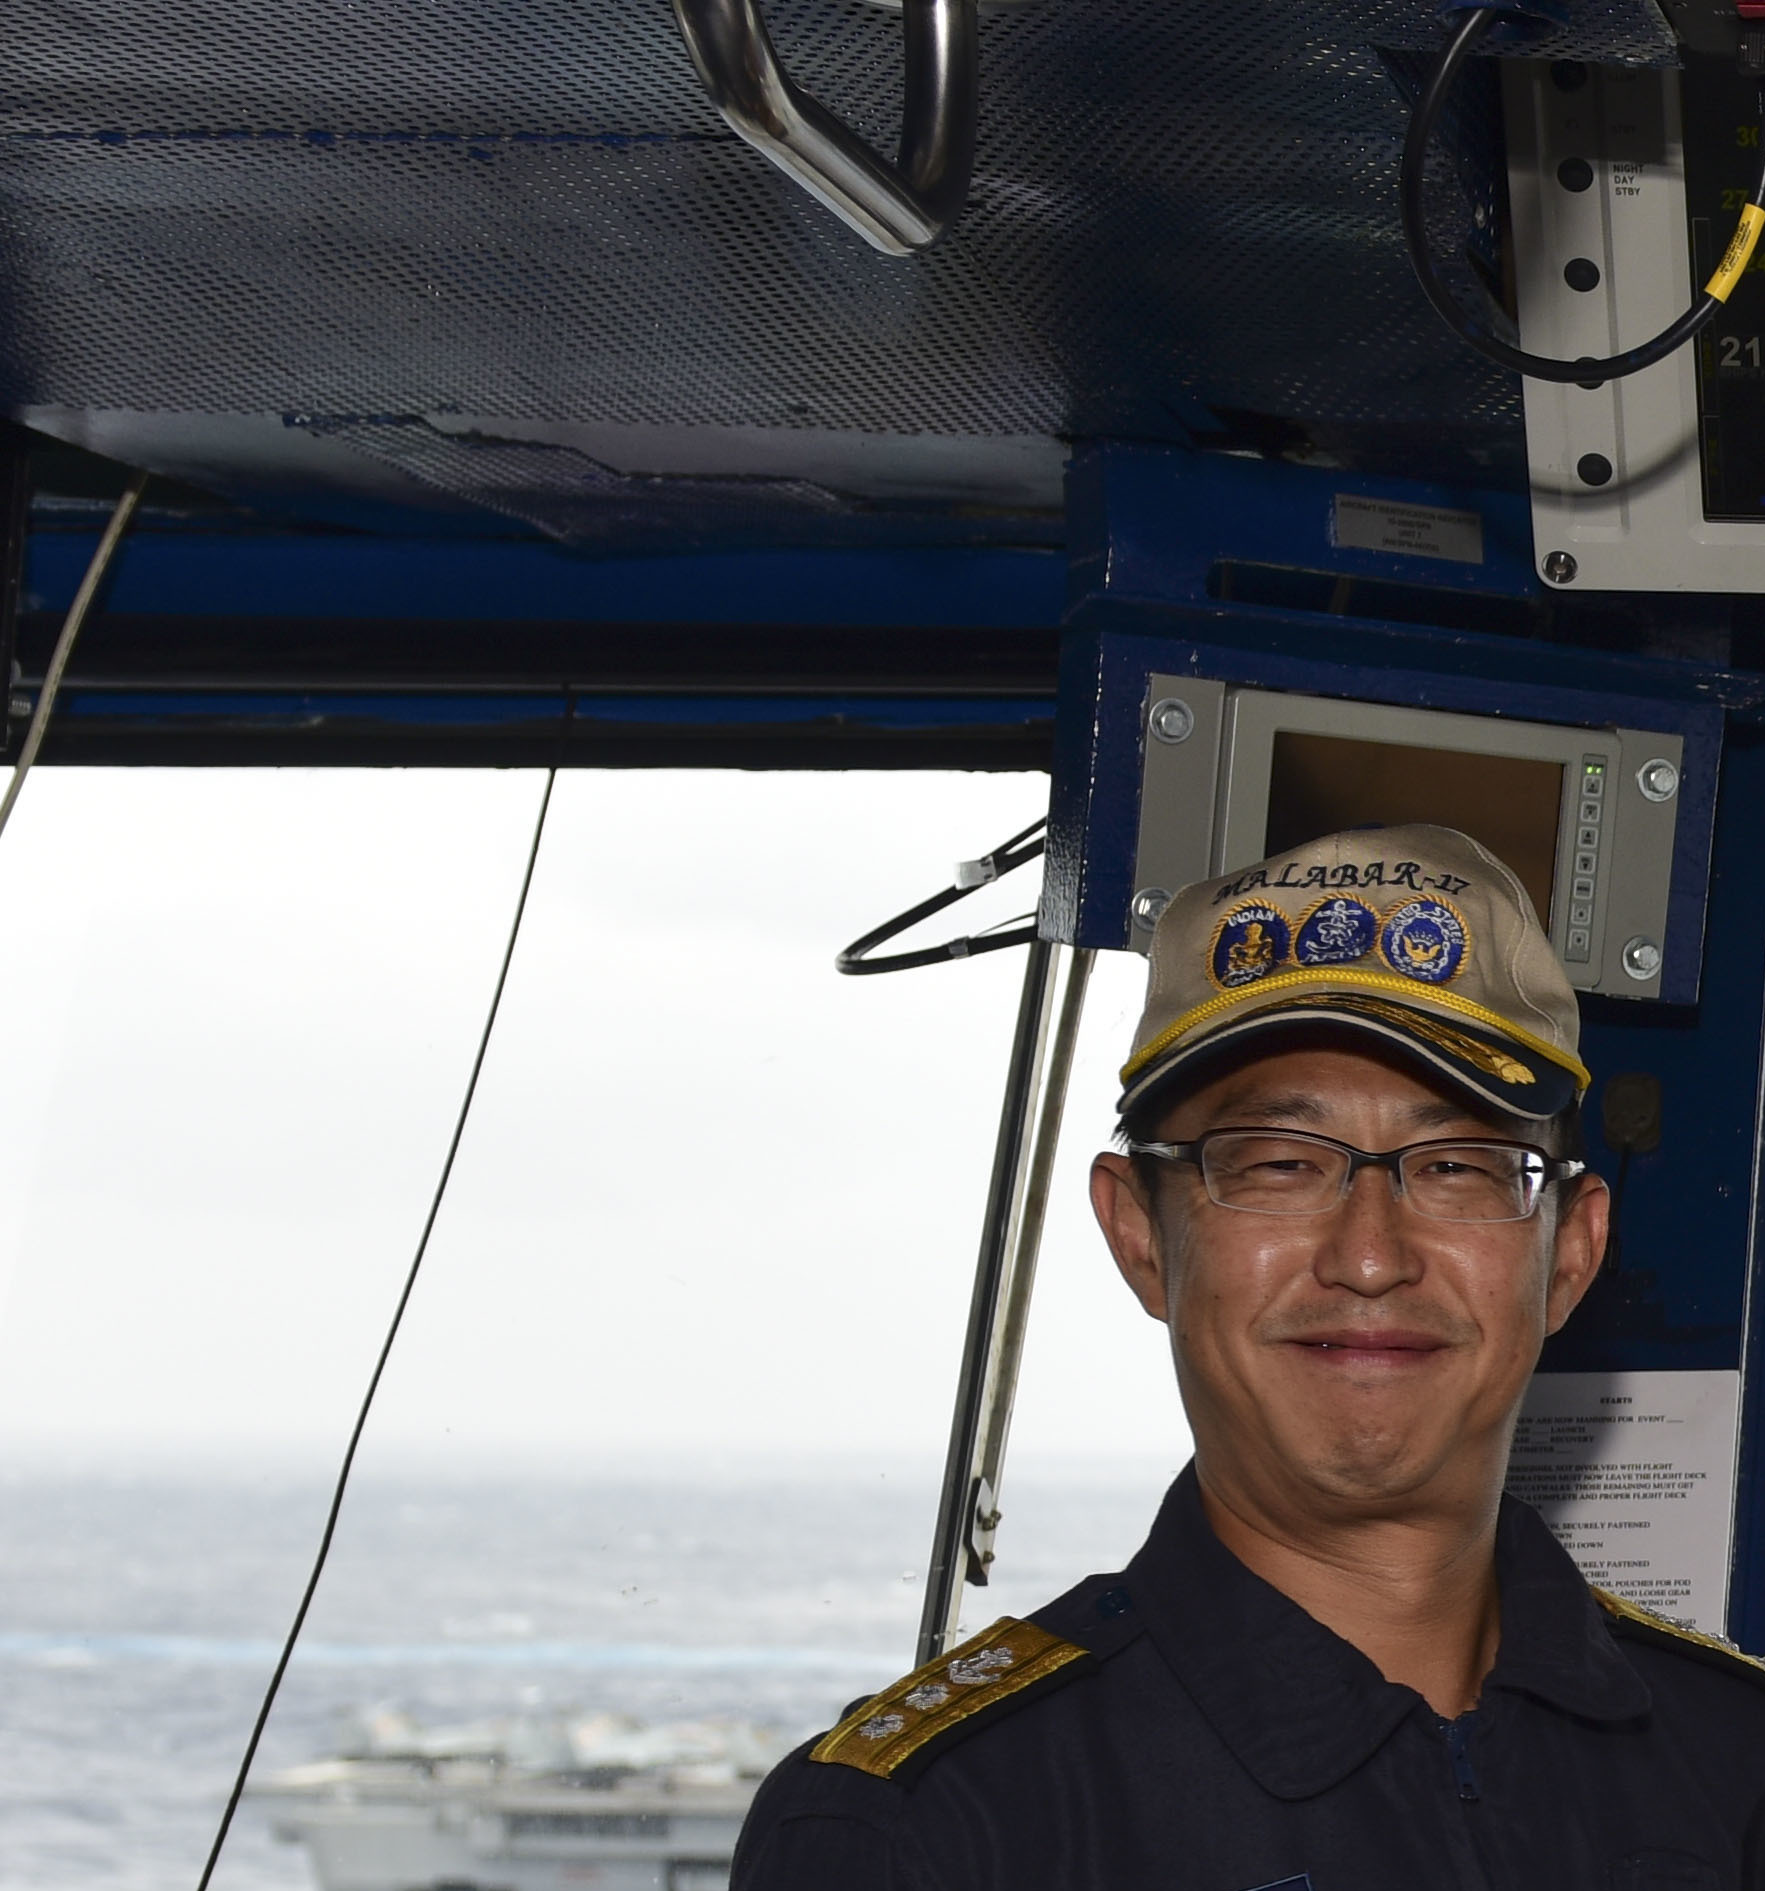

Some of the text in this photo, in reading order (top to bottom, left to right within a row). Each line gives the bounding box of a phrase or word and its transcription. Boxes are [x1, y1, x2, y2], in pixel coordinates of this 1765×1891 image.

[1612, 163, 1645, 174] NIGHT
[1614, 175, 1635, 185] DAY
[1615, 187, 1641, 197] STBY
[1211, 861, 1471, 905] MALABAR-17
[1637, 1415, 1665, 1423] EVENT
[1562, 1521, 1650, 1530] SECURELY FASTENED
[1607, 1560, 1650, 1568] FASTENED
[1615, 1579, 1653, 1587] POUCHES
